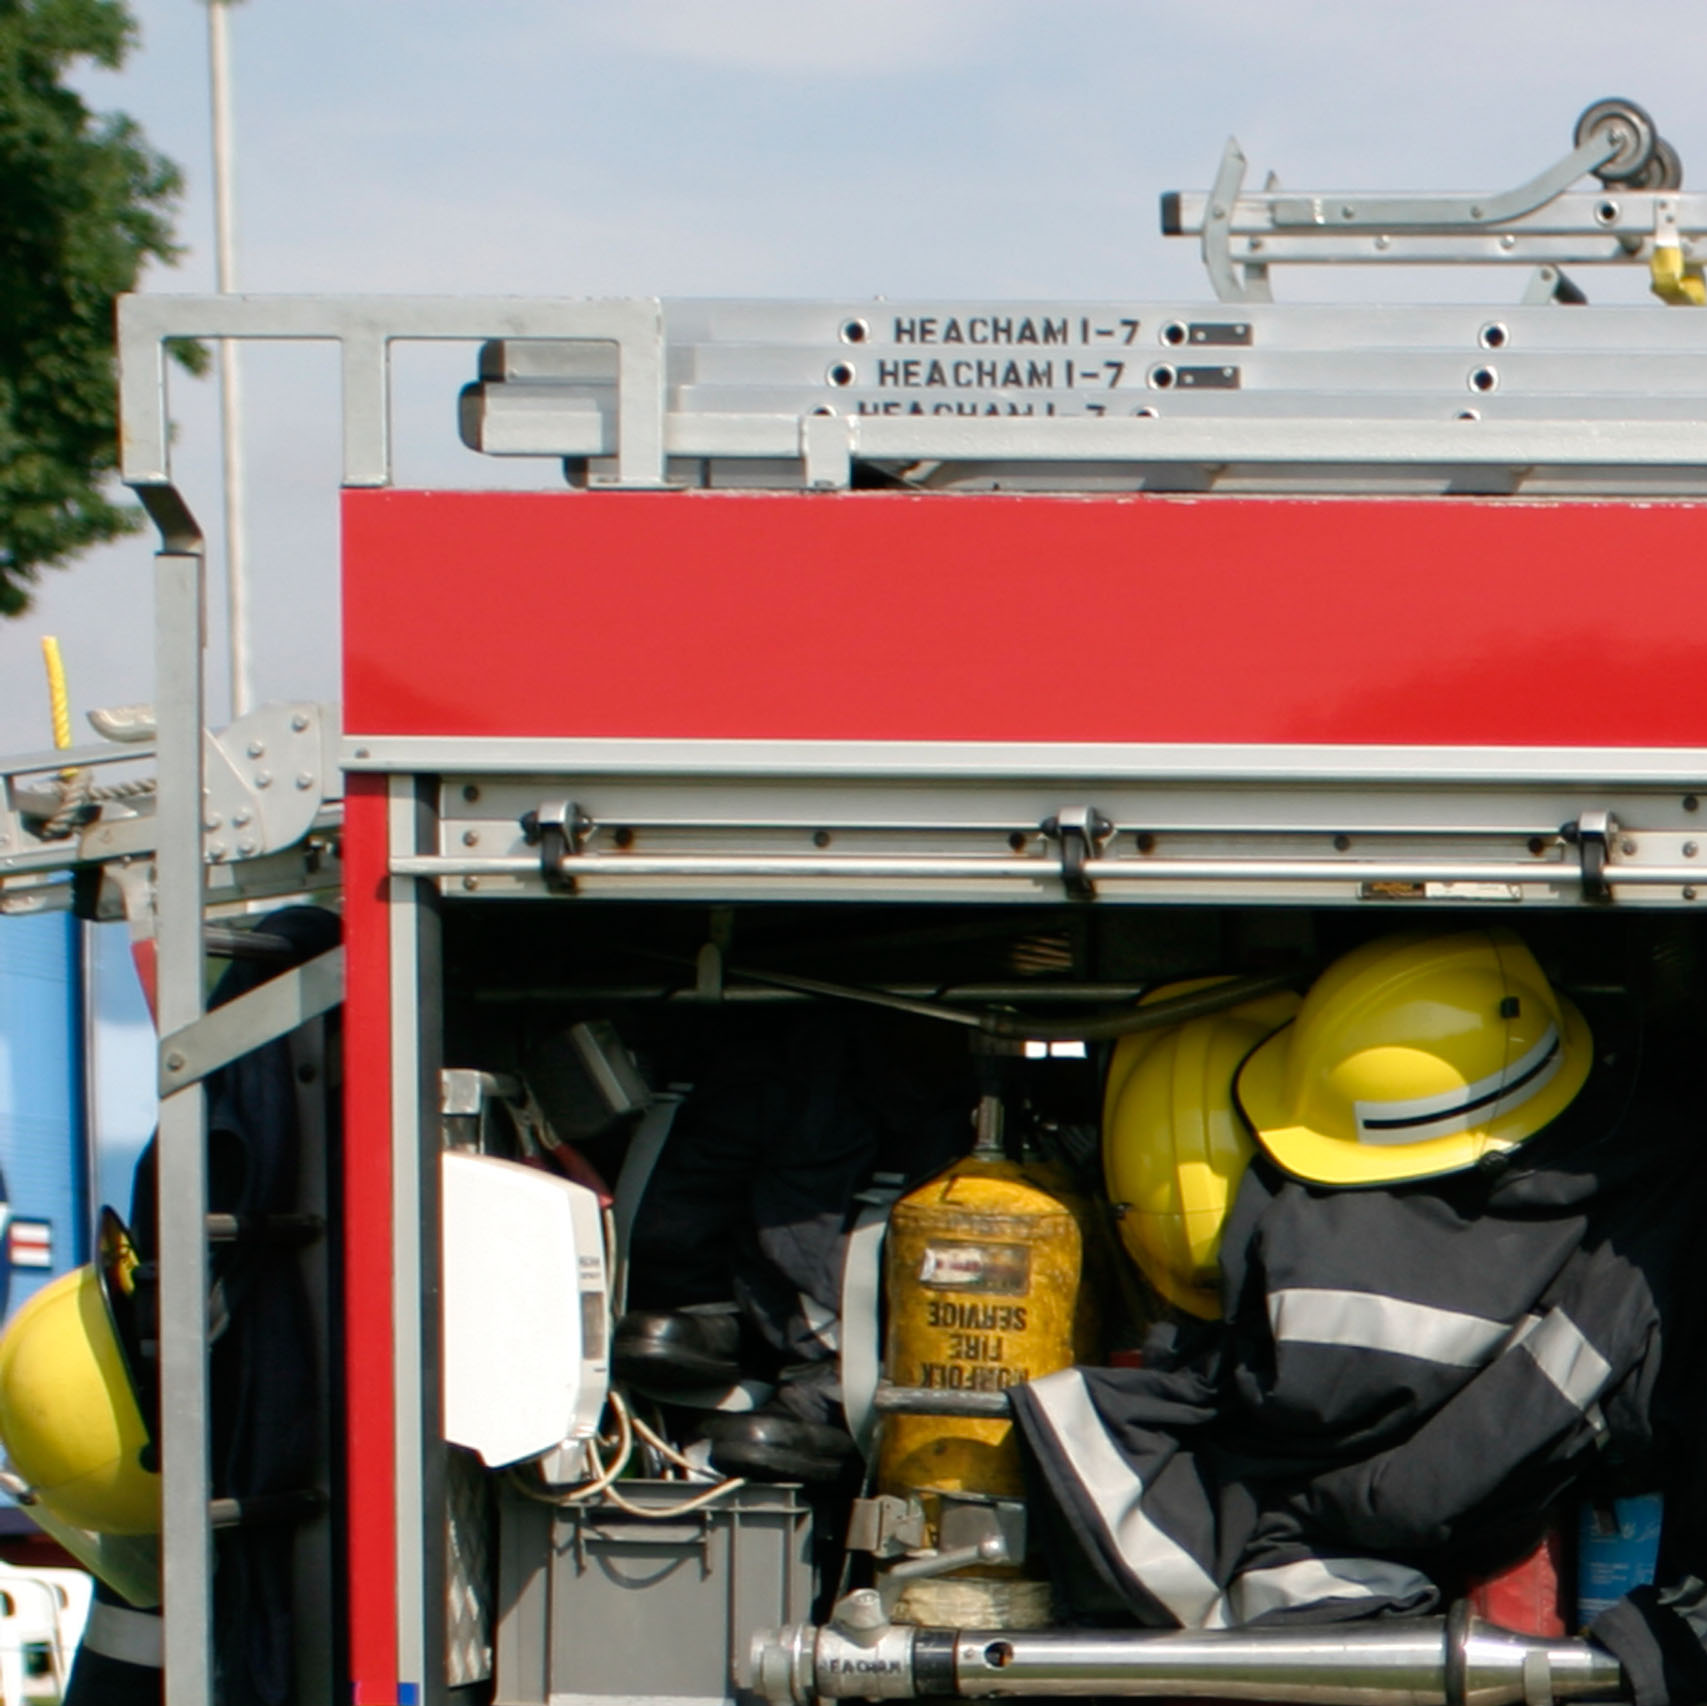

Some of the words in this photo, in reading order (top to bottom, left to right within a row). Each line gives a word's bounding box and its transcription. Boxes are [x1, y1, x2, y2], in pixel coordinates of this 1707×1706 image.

[894, 317, 1068, 345] HEACHAM
[878, 359, 1052, 388] HEACHAM
[928, 1302, 1027, 1332] SERVICE
